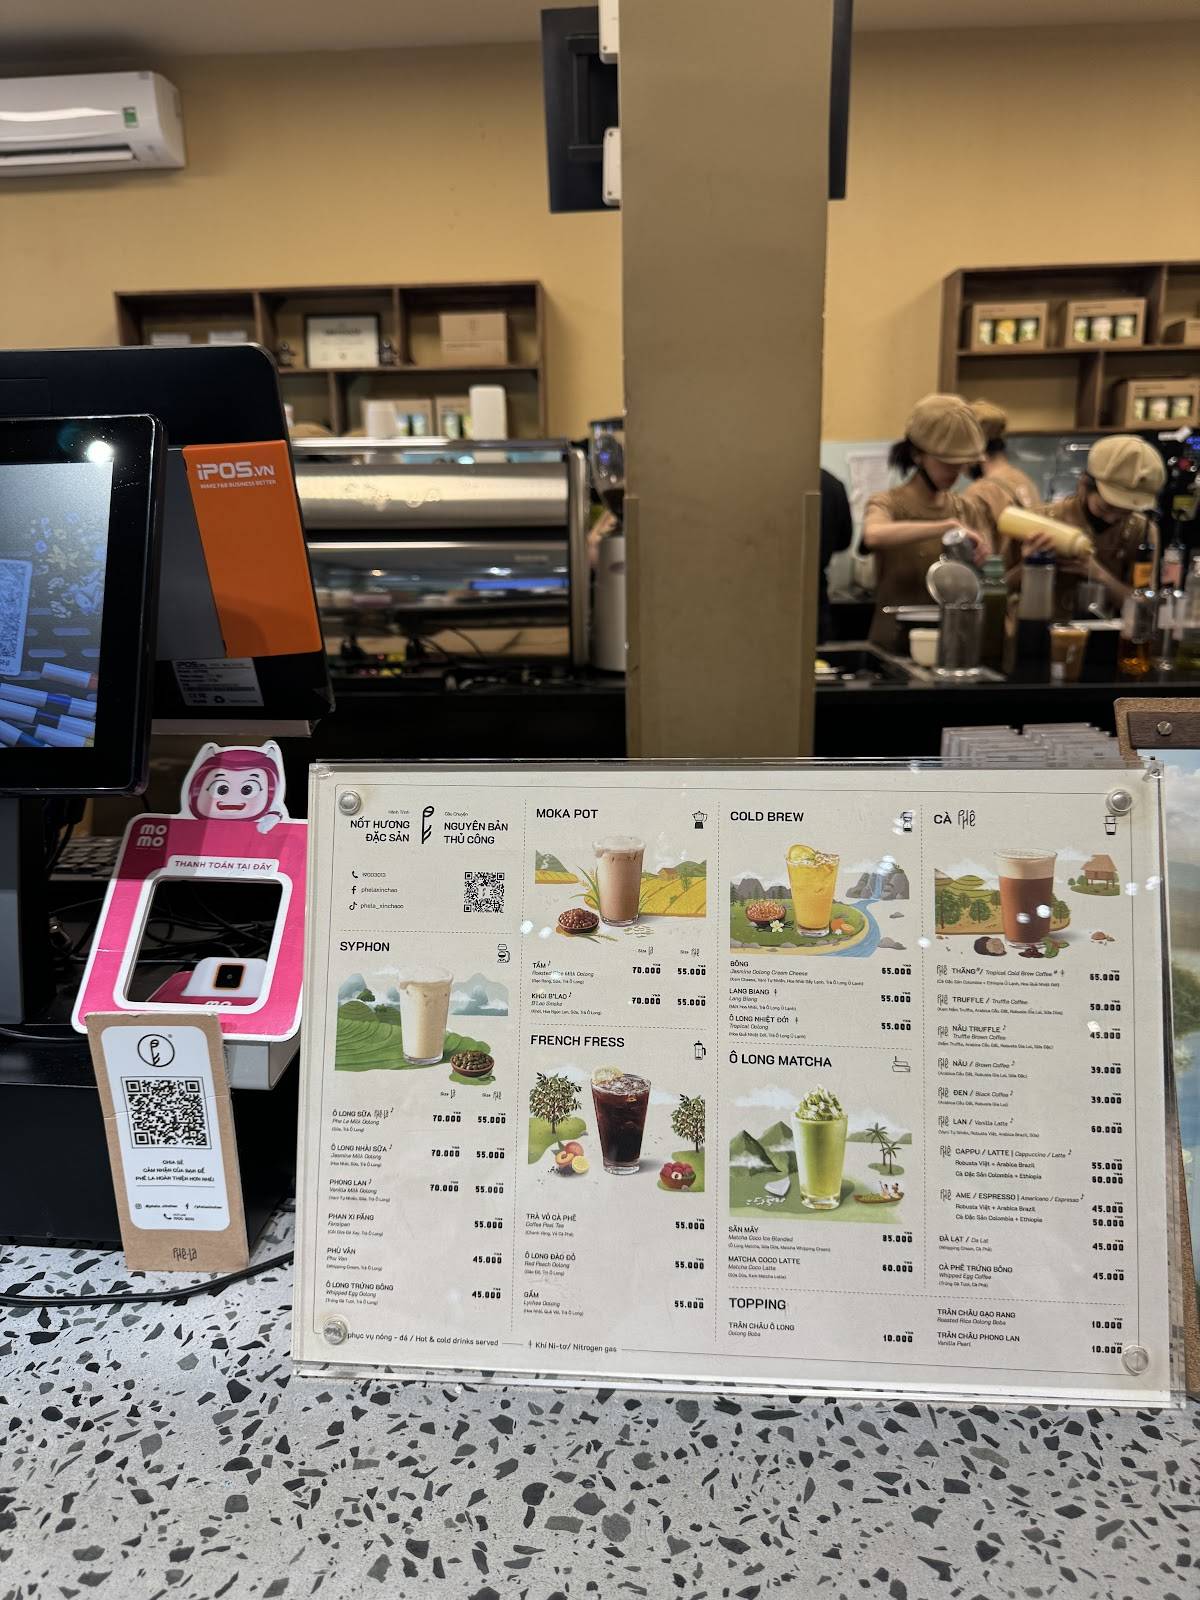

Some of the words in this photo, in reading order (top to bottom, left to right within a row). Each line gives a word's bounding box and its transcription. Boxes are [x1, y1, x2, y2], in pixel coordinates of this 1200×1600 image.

[536, 808, 570, 818] MOKA
[574, 809, 598, 818] POT
[730, 811, 763, 821] COLD
[767, 812, 803, 822] BREW
[349, 816, 370, 828] NỐT
[373, 819, 409, 829] HƯƠNG
[933, 813, 951, 824] CÀ
[444, 819, 485, 830] NGUYÊN
[488, 819, 508, 830] BẢN
[365, 830, 386, 843] ĐẶC
[388, 830, 409, 841] SẢN
[443, 832, 464, 843] THỦ
[467, 833, 494, 844] CÔNG
[174, 860, 206, 868] THANH
[208, 860, 234, 868] TOÁN
[237, 863, 250, 871] TẠI
[253, 862, 271, 870] ĐÂY
[340, 941, 389, 952] SYPHON
[632, 965, 660, 974] 70.000
[678, 967, 705, 975] 55.000
[632, 996, 660, 1004] 70.000
[677, 998, 705, 1006] 55.000
[881, 994, 910, 1002] 55.000
[1090, 1003, 1120, 1011] 50.000
[729, 1014, 733, 1022] Ô
[881, 1022, 910, 1030] 55.000
[968, 1026, 1000, 1034] TRUFFLE
[1090, 1031, 1120, 1039] 45.000
[530, 1034, 580, 1046] FRENCH
[584, 1036, 624, 1047] FRESS
[729, 1049, 737, 1063] Ô
[742, 1054, 774, 1064] LONG
[778, 1055, 831, 1067] MATCHA
[952, 1059, 967, 1067] NÂU
[1091, 1066, 1120, 1074] 39.000
[1091, 1096, 1121, 1104] 39.000
[332, 1109, 337, 1117] Ô
[338, 1110, 355, 1118] LONG
[433, 1114, 460, 1122] 70.000
[478, 1115, 505, 1124] 55.000
[331, 1143, 335, 1152] Ô
[337, 1144, 354, 1152] LONG
[432, 1149, 459, 1157] 70.000
[476, 1150, 504, 1158] 55.000
[1092, 1162, 1122, 1171] 55.000
[430, 1184, 458, 1192] 70.000
[475, 1185, 503, 1193] 55.000
[978, 1192, 1016, 1200] ESPRESSO
[1092, 1204, 1122, 1213] 45.000
[356, 1212, 373, 1220] PĂNG
[526, 1211, 539, 1221] TRÀ
[552, 1213, 561, 1222] CÀ
[562, 1213, 576, 1221] PHÊ
[474, 1220, 502, 1228] 55.000
[675, 1221, 704, 1229] 55.000
[1092, 1242, 1123, 1251] 45.000
[524, 1250, 529, 1258] Ô
[473, 1255, 501, 1263] 45.000
[675, 1260, 704, 1269] 55.000
[938, 1262, 948, 1270] CÀ
[950, 1262, 965, 1272] PHÊ
[1093, 1272, 1124, 1280] 45.000
[325, 1280, 332, 1288] Ô
[332, 1282, 350, 1290] LONG
[472, 1289, 500, 1298] 45.000
[674, 1300, 703, 1308] 55.000
[729, 1297, 785, 1310] TOPPING
[994, 1311, 1015, 1319] RANG
[770, 1321, 774, 1330] Ô
[1092, 1320, 1121, 1329] 10.000
[375, 1333, 392, 1341] nóng
[475, 1338, 498, 1346] served
[883, 1334, 912, 1342] 10.000
[573, 1343, 602, 1352] Nitrogen
[1092, 1345, 1121, 1353] 10.000
